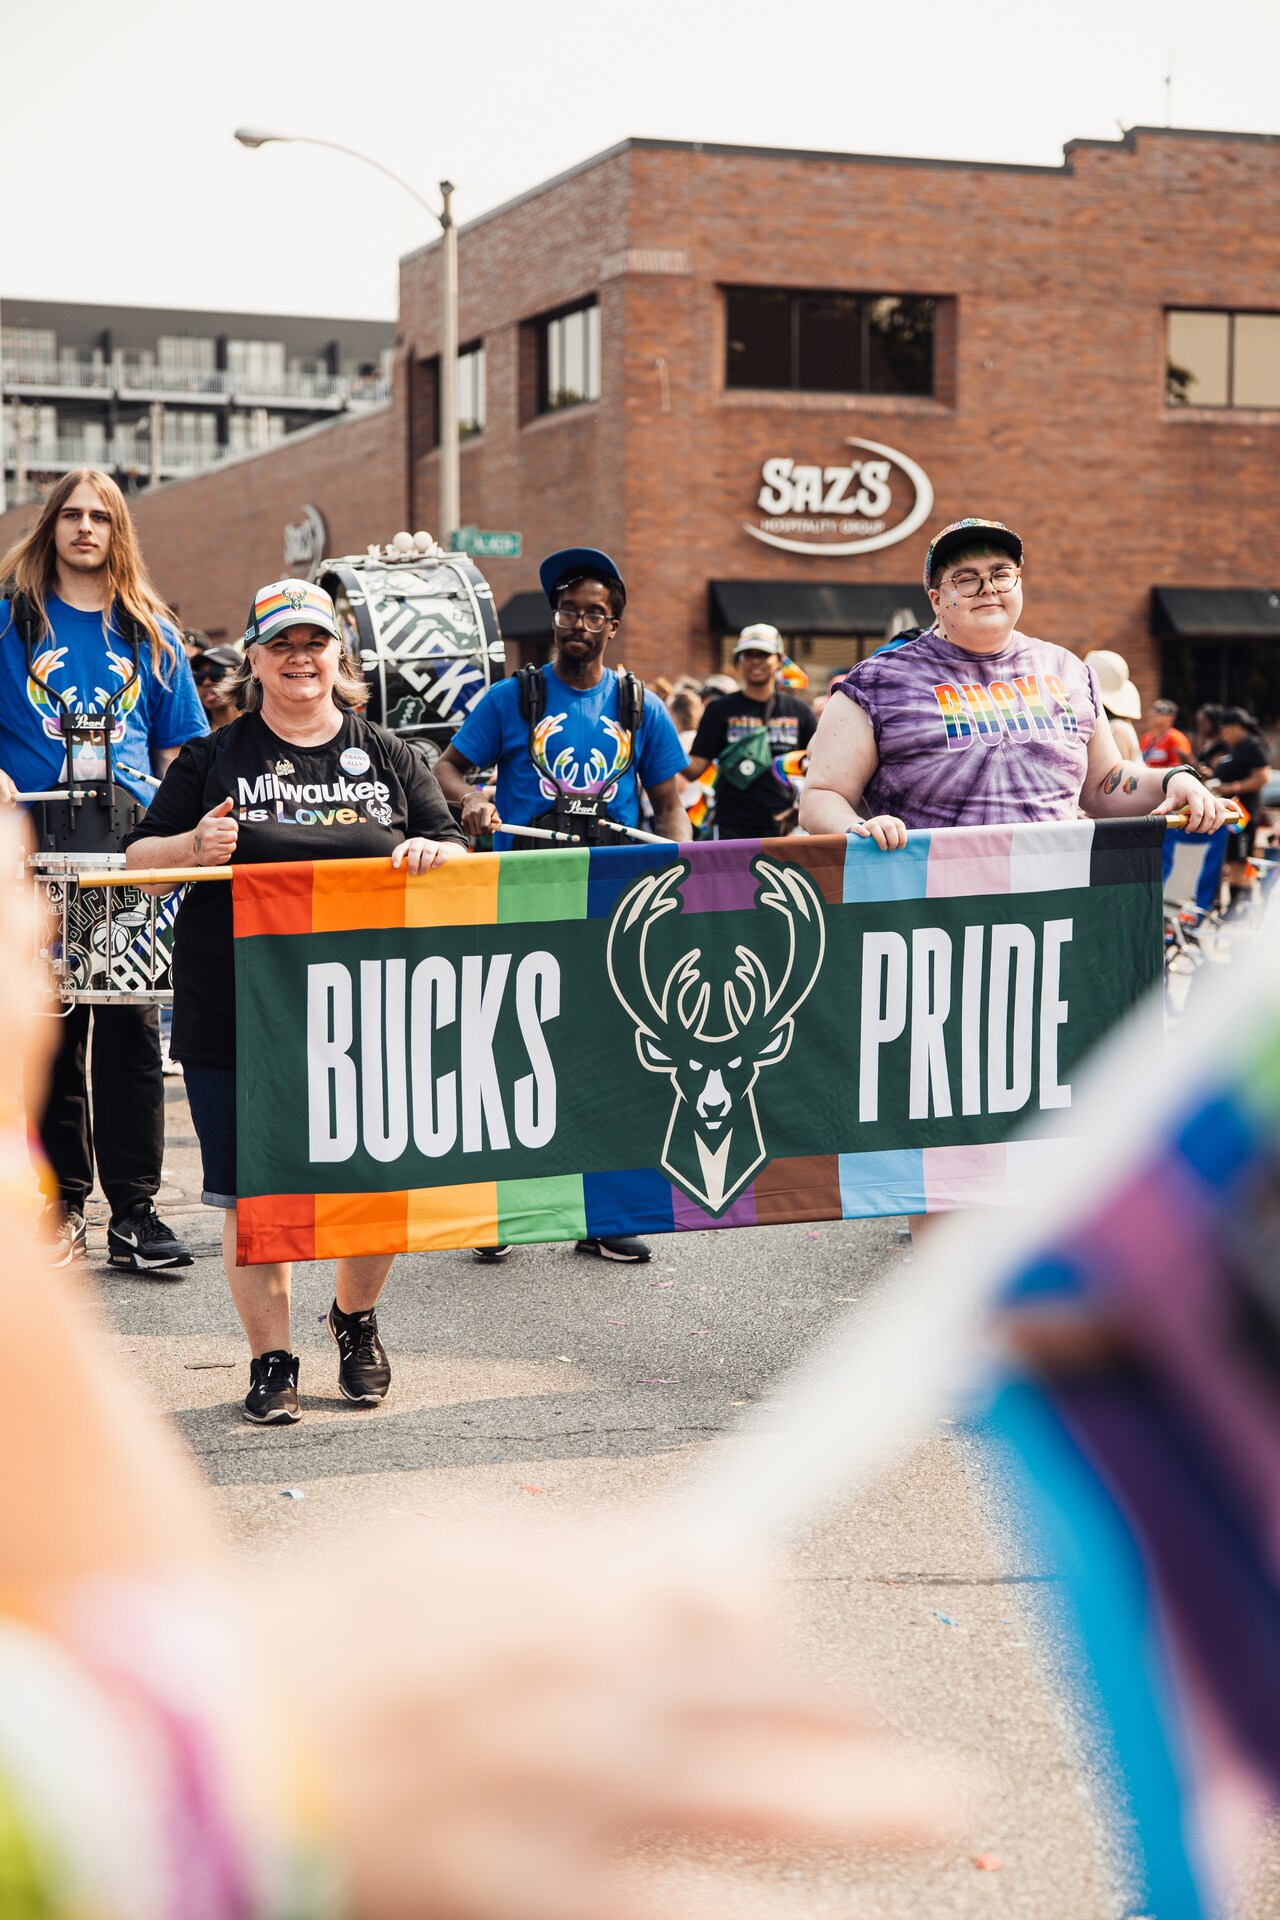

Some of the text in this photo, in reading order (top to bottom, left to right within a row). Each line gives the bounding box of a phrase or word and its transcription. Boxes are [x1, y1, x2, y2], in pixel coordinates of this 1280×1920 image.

[757, 457, 892, 518] SAZ'S
[71, 713, 106, 729] Pearl
[932, 673, 1079, 752] BUCKS
[344, 754, 367, 762] TRANS
[237, 773, 390, 806] Milwaukee
[239, 800, 368, 826] is Love.
[564, 800, 599, 815] Pearl
[307, 918, 1074, 1164] BUCKS PRIDE
